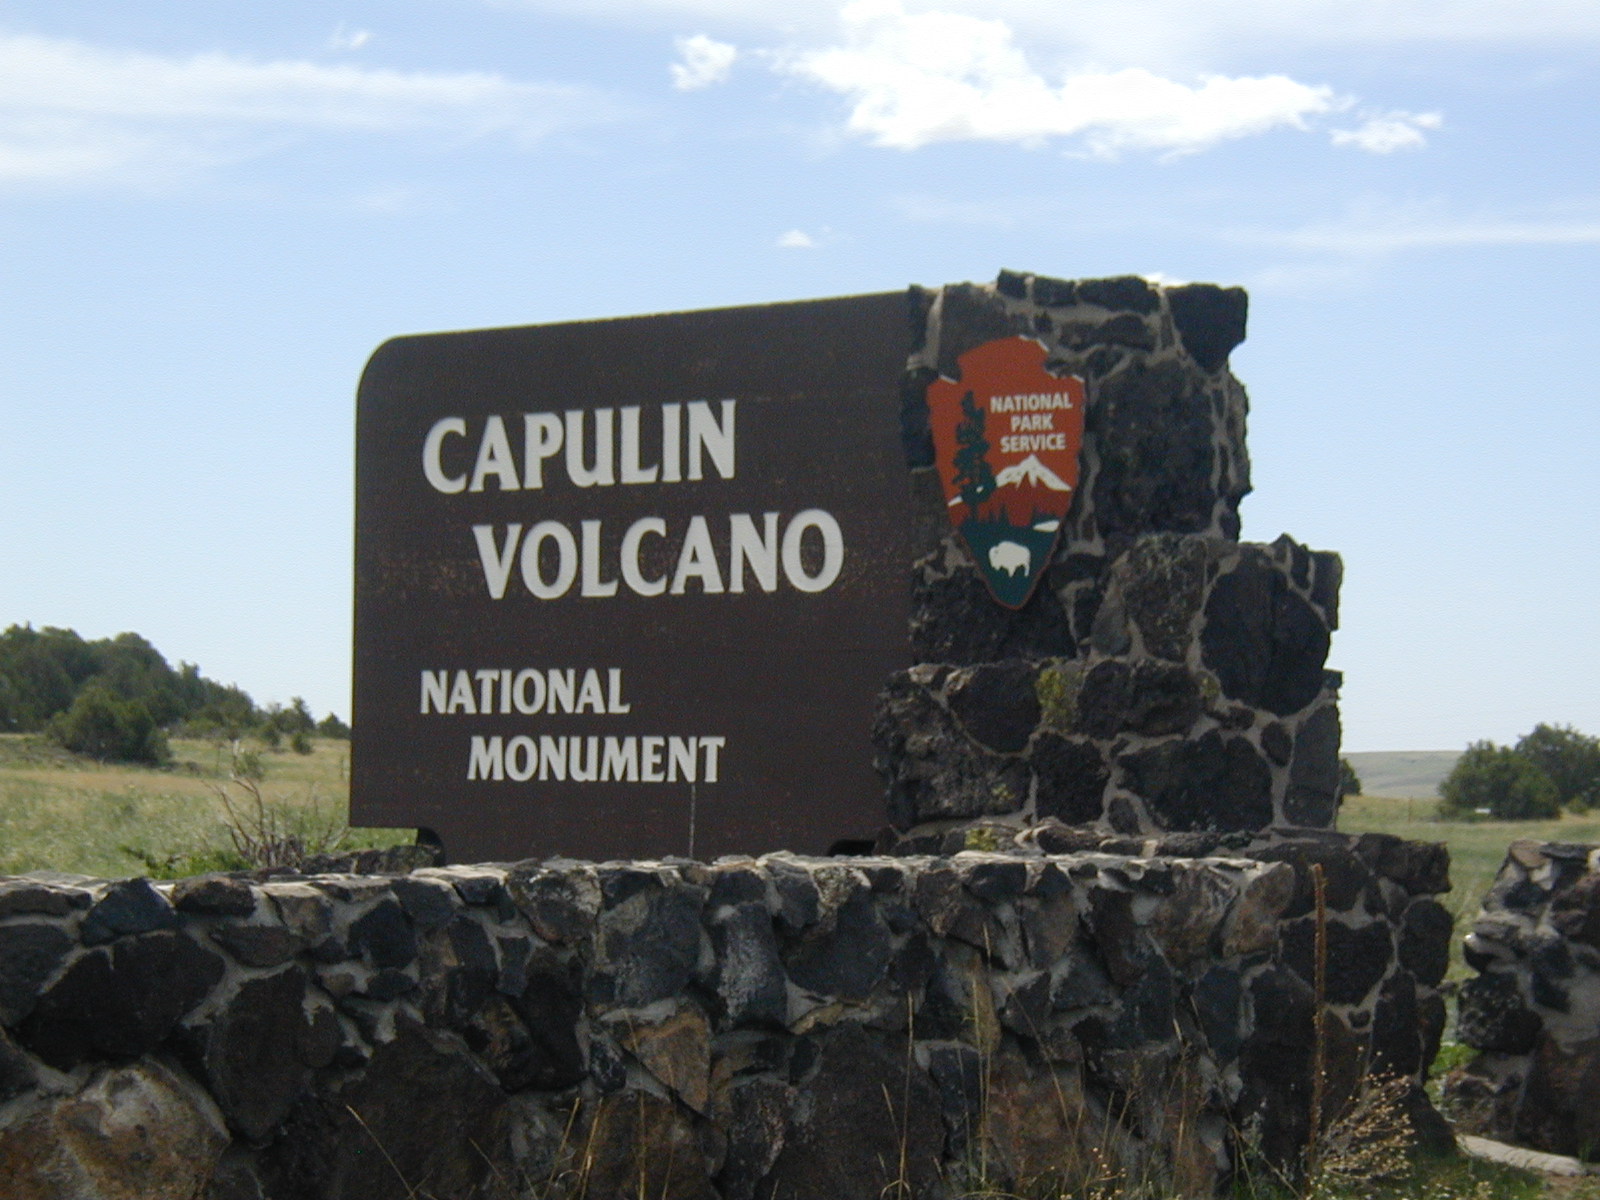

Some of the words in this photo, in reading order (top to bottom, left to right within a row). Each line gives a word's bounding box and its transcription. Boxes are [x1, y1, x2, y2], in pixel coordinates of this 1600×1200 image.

[990, 392, 1073, 412] NATIONAL
[1011, 413, 1054, 431] PARK
[422, 399, 736, 493] CAPULIN
[1001, 433, 1066, 452] SERVICE
[473, 509, 844, 599] VOLCANO
[420, 668, 630, 714] NATIONAL
[467, 735, 725, 783] MONUMENT
